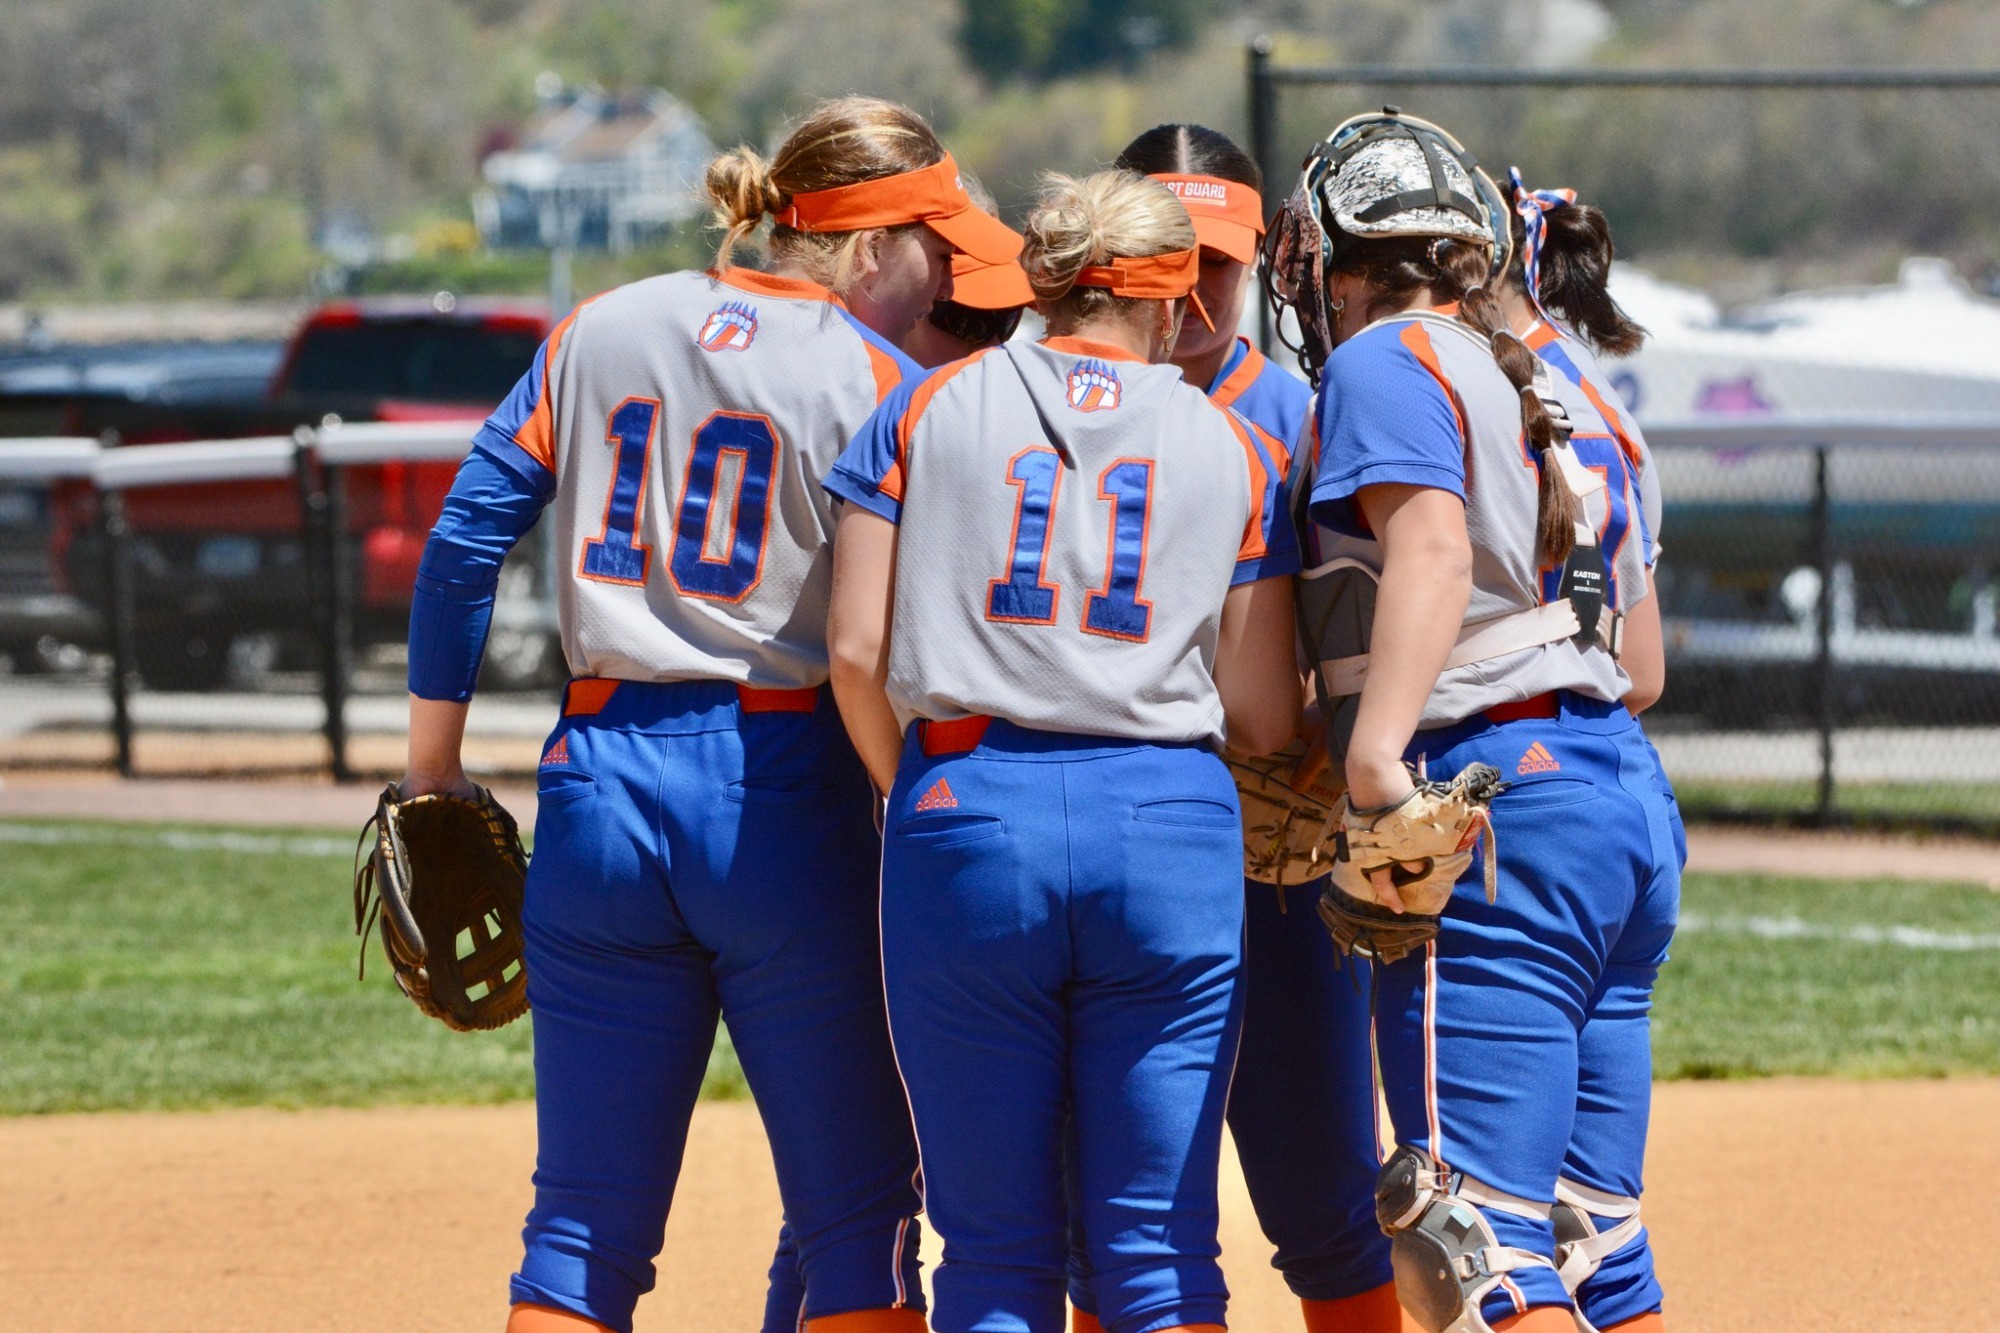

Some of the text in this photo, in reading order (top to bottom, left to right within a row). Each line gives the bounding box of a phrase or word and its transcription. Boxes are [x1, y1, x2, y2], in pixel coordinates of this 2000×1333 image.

[1185, 182, 1226, 199] GUARD
[577, 395, 783, 604] 10
[984, 444, 1156, 644] 11
[1573, 570, 1601, 580] EASTON
[1517, 760, 1560, 776] adidas
[915, 797, 958, 812] adidas
